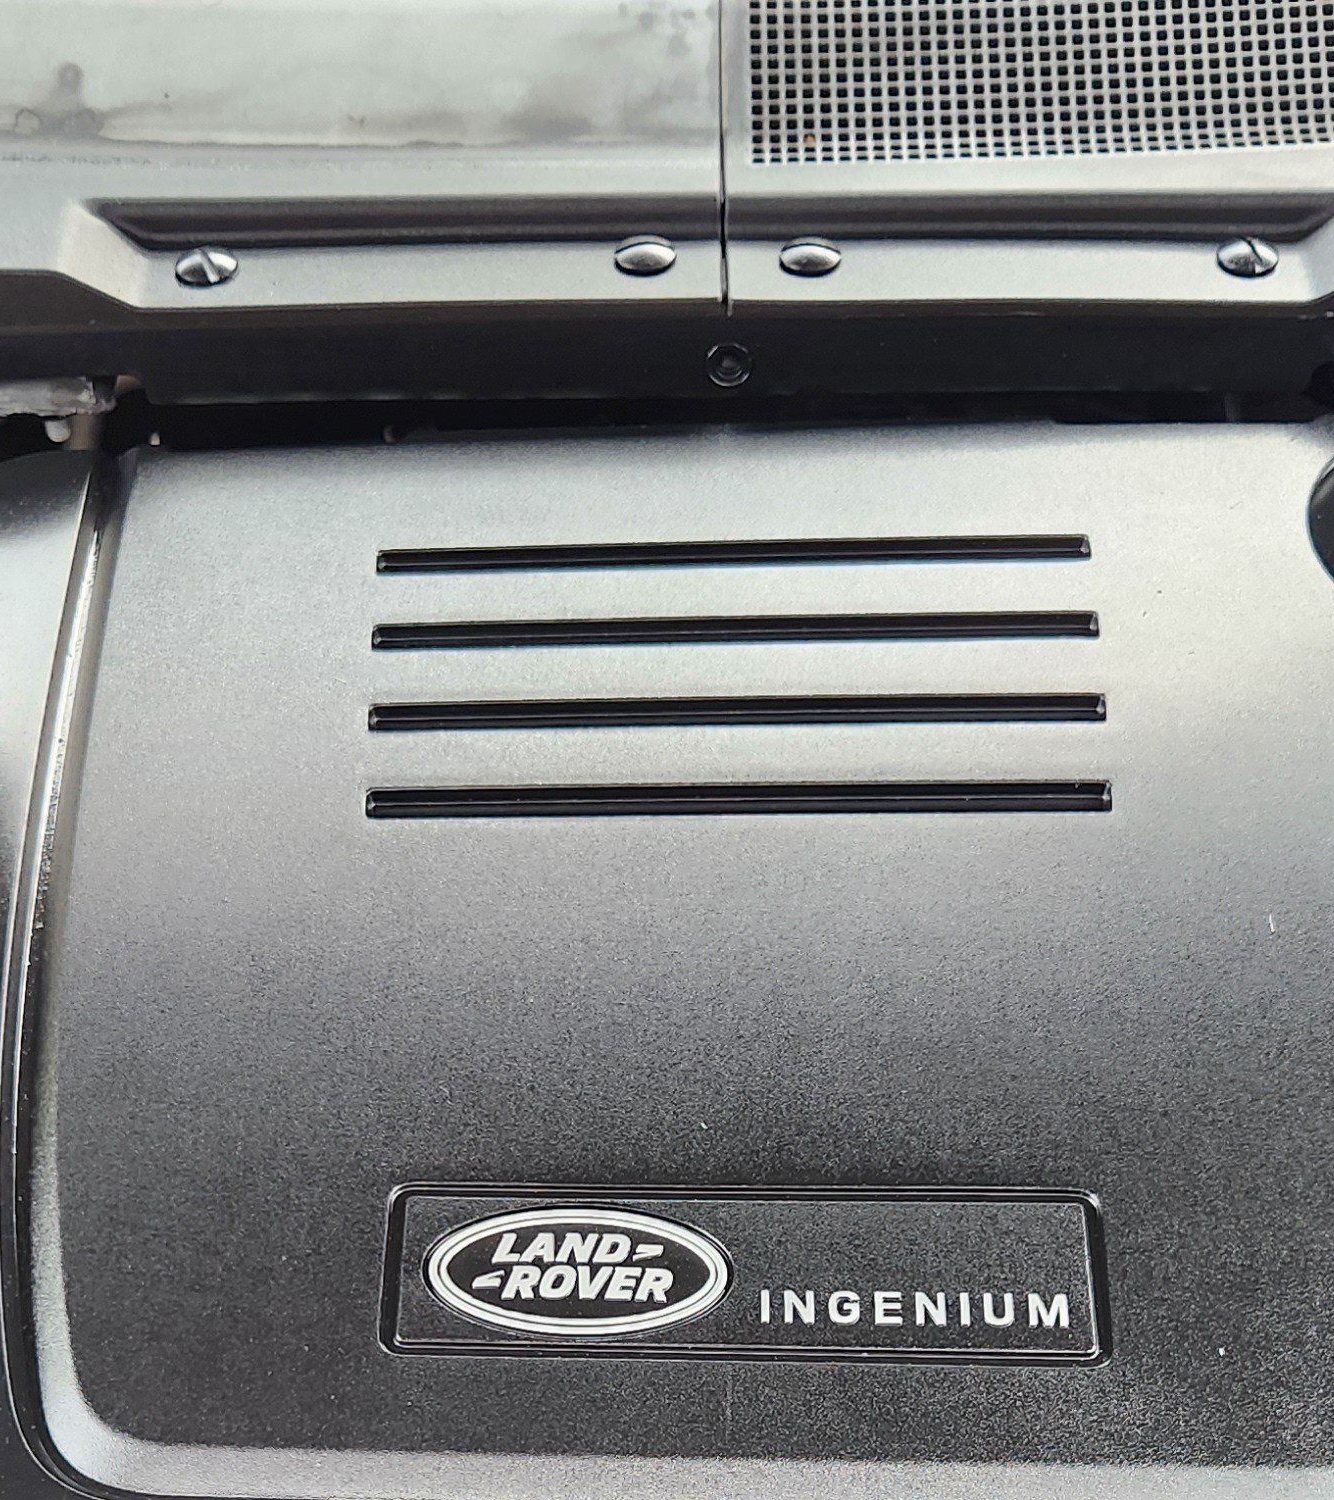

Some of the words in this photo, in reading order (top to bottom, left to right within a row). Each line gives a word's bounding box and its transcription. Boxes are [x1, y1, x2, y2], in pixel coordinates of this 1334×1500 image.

[491, 1232, 633, 1264] LAND
[500, 1265, 674, 1304] ROVER
[760, 1288, 1070, 1329] INGENIUM
